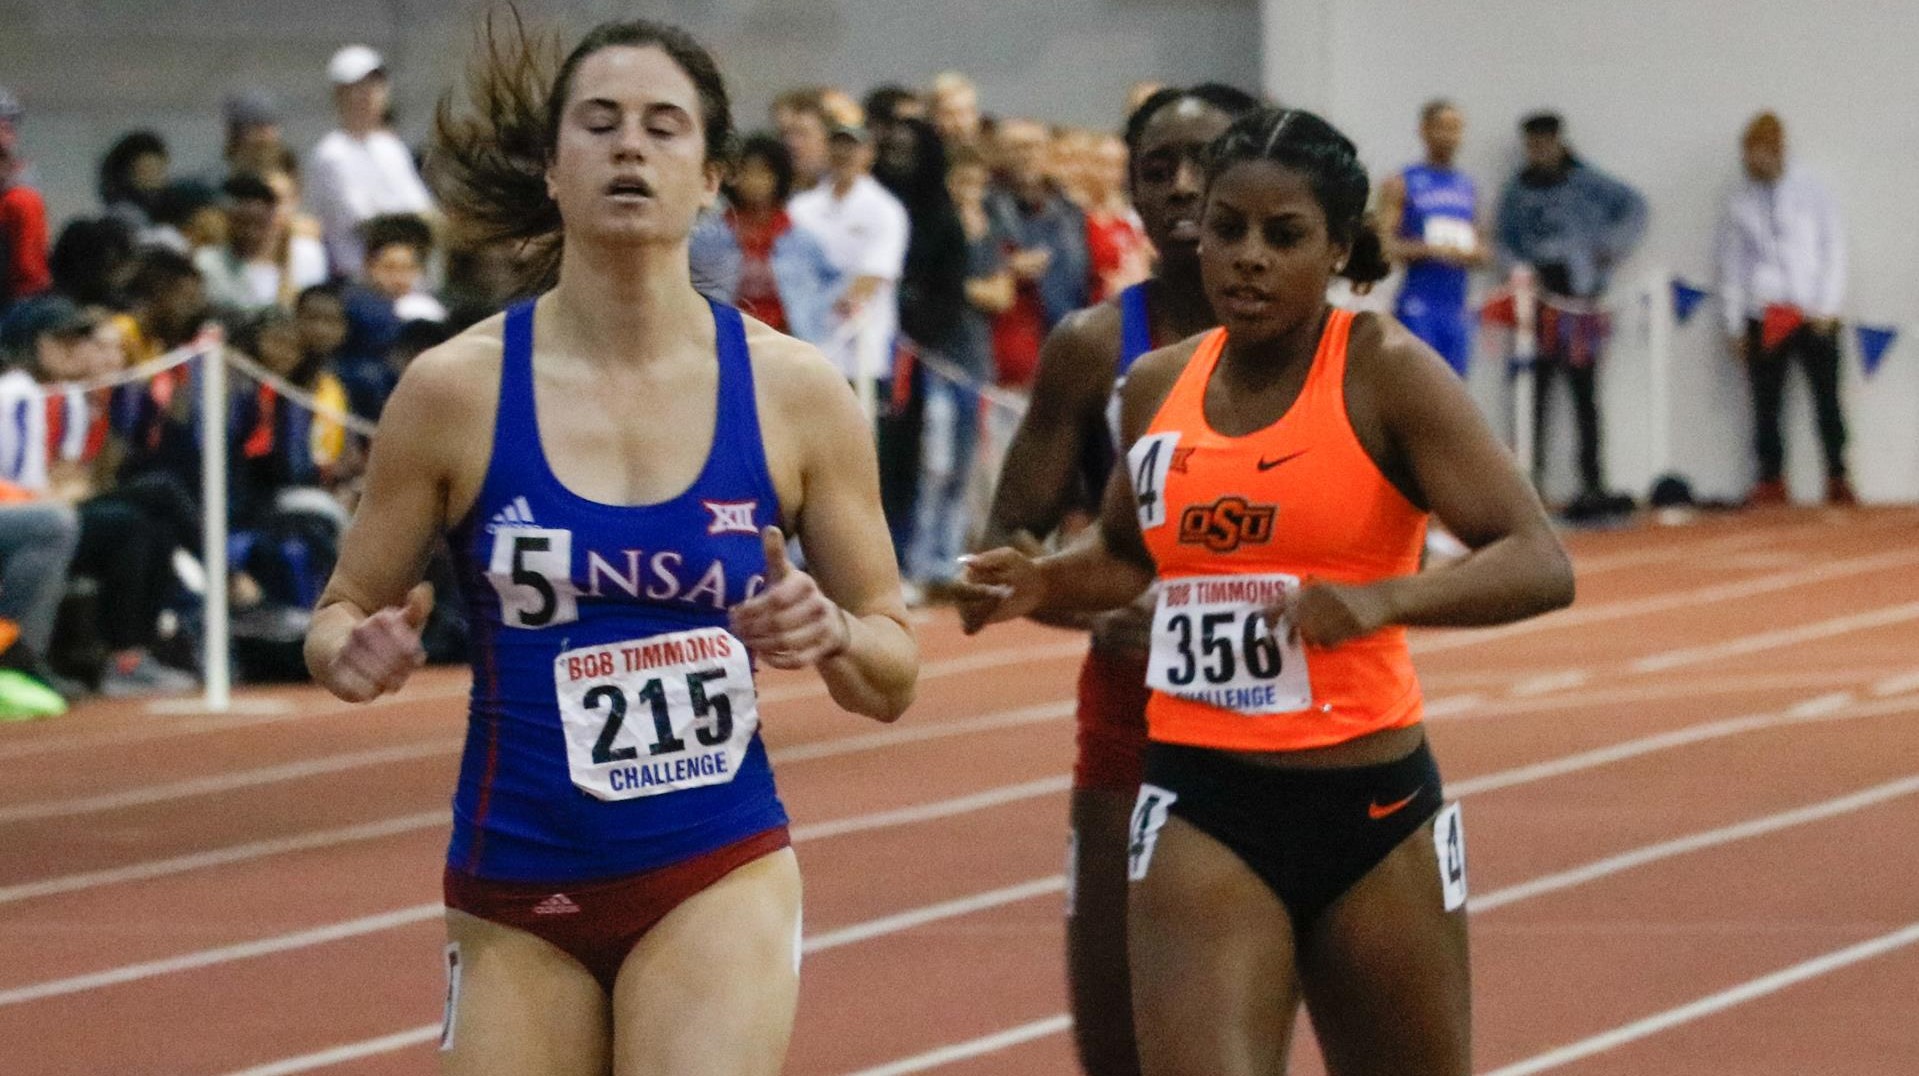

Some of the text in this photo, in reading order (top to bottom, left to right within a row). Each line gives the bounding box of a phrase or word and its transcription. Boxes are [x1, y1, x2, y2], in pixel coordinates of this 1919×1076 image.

[1138, 440, 1162, 521] 4
[1178, 496, 1279, 554] OSU
[511, 536, 557, 626] 5
[574, 549, 765, 609] NSA
[1166, 580, 1286, 607] BOB TIMMONS
[567, 634, 732, 682] BOB TIMMONS
[1167, 611, 1283, 686] 356
[582, 667, 734, 765] 215
[1175, 685, 1276, 709] ALLENGE
[610, 752, 729, 792] CHALLENGE
